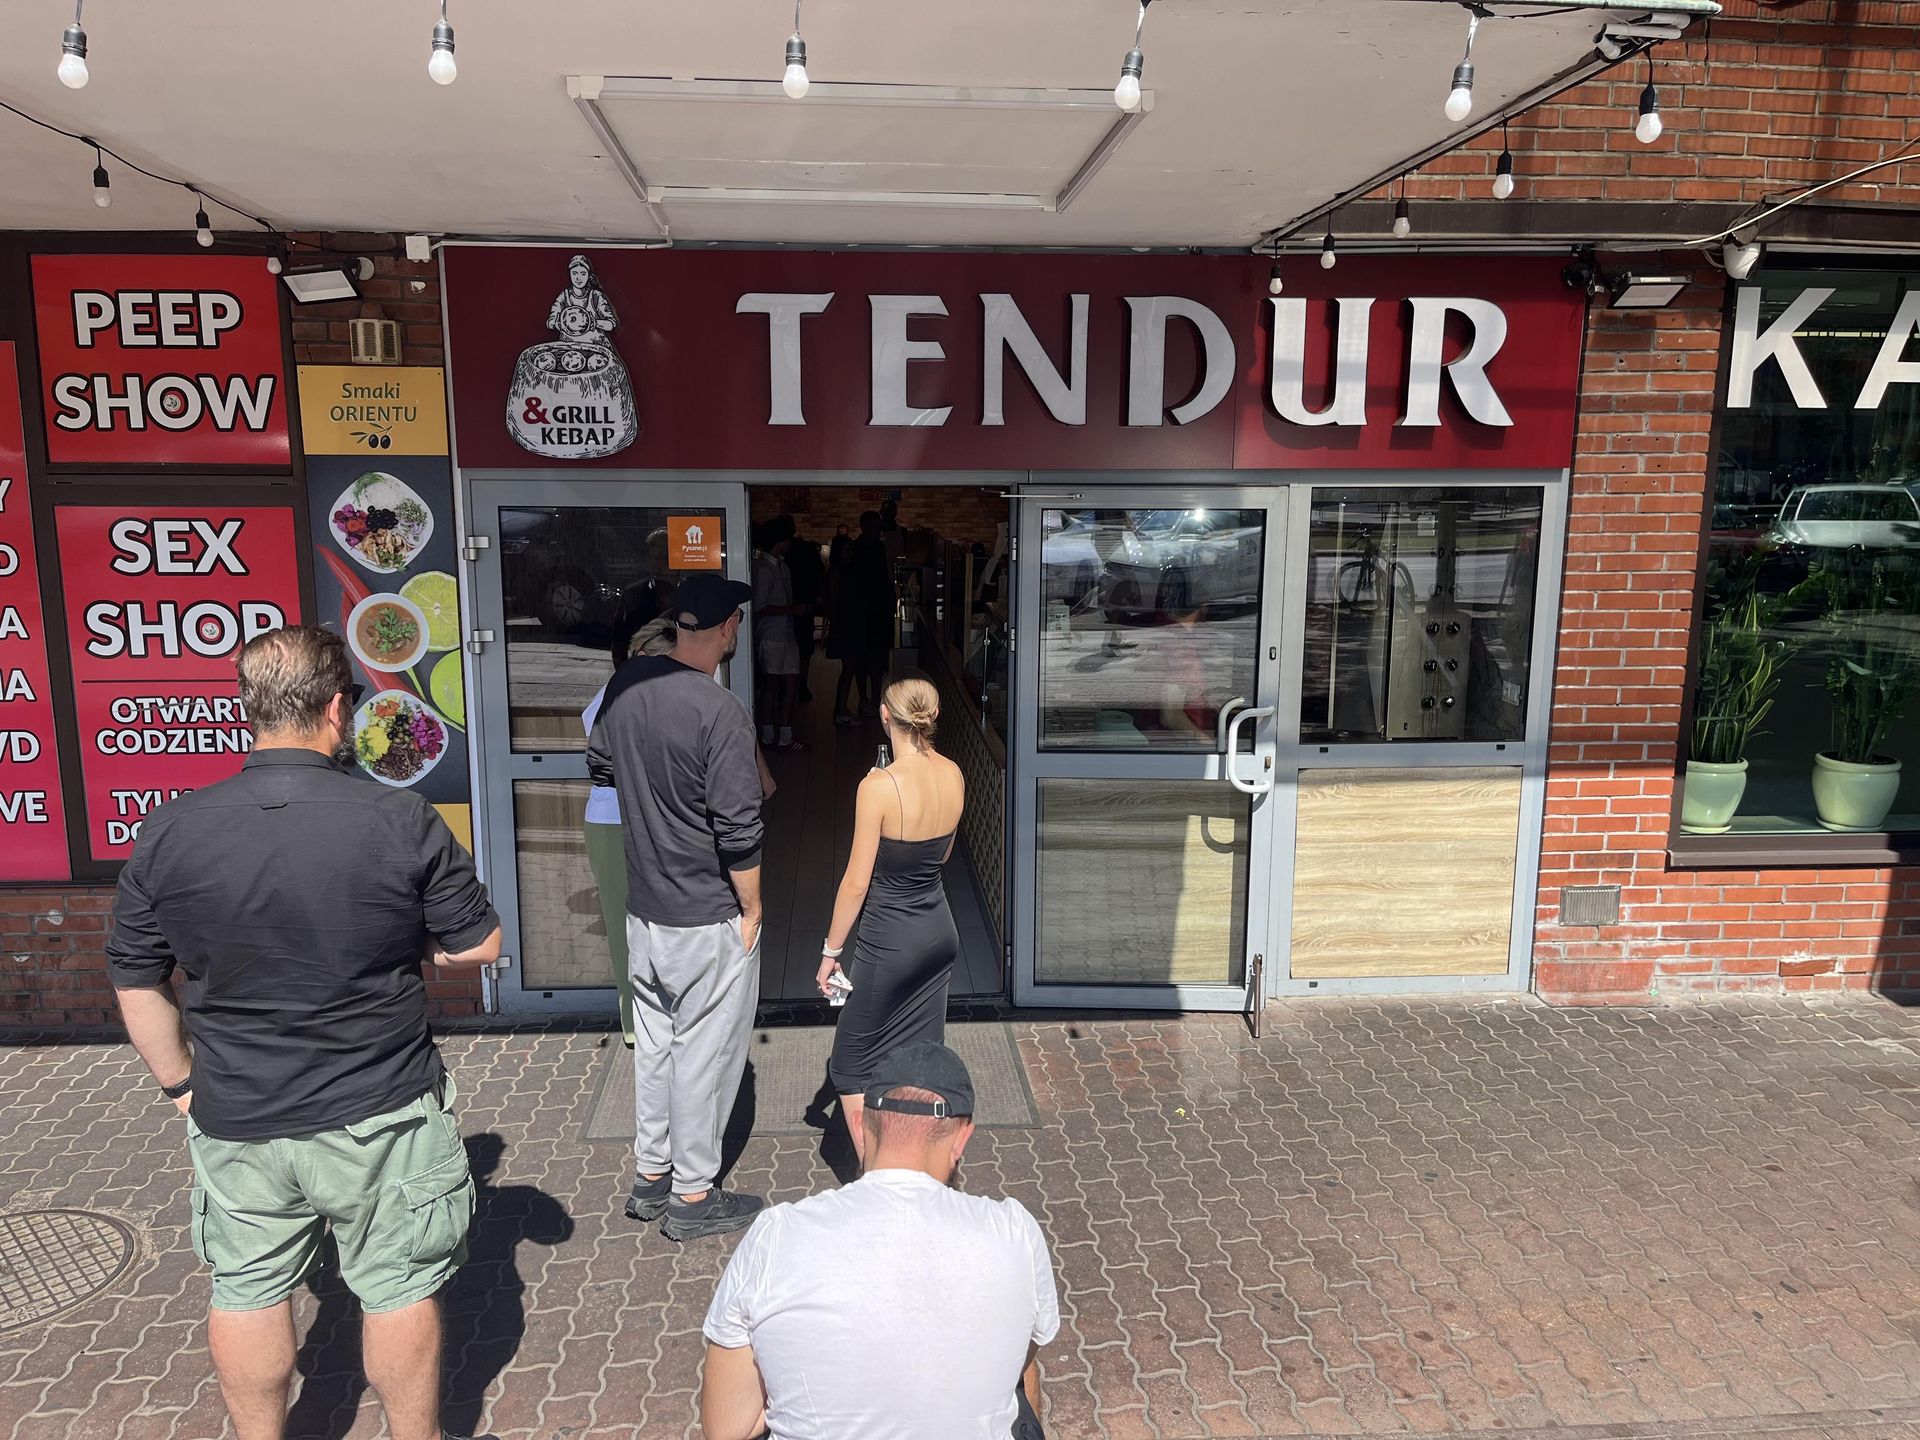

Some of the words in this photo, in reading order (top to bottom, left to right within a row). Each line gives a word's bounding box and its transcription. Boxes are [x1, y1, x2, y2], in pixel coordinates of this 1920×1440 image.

[72, 290, 242, 348] PEEP
[735, 291, 1515, 427] TENDUR
[54, 374, 276, 431] SHOW
[342, 381, 401, 399] Smaki
[330, 405, 417, 423] ORIENTU
[522, 396, 551, 425] &
[552, 405, 615, 424] GRILL
[541, 427, 615, 445] KEBAP
[110, 518, 248, 575] SEX
[0, 606, 30, 640] A
[84, 600, 286, 658] SHOP
[0, 668, 37, 702] A
